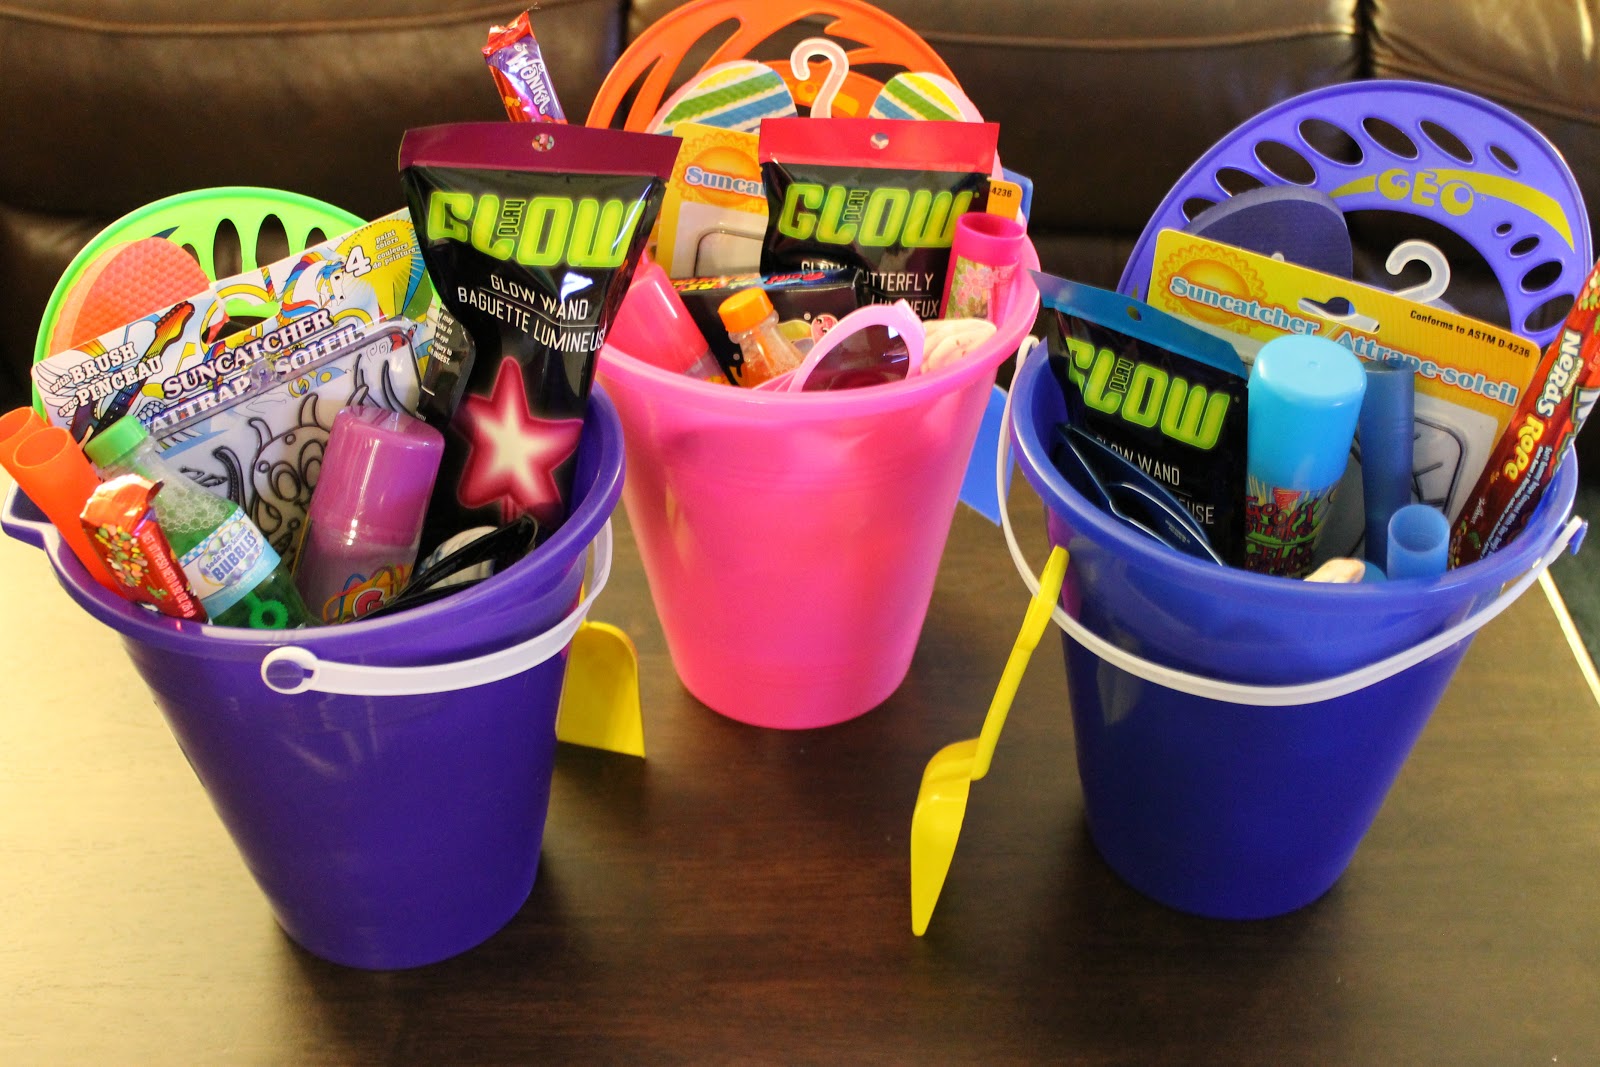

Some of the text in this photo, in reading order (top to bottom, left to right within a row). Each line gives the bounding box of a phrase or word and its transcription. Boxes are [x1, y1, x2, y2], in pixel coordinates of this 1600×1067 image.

[778, 182, 973, 248] GLOW
[1377, 168, 1474, 216] GEO
[375, 229, 396, 245] paint
[375, 236, 399, 250] colors
[377, 242, 409, 260] couleurs
[427, 190, 646, 268] GLOW
[345, 245, 372, 278] 4
[384, 247, 416, 266] peinture
[490, 273, 589, 320] GLOW WAND
[862, 271, 934, 292] UTTERFLY
[457, 286, 608, 353] BAGUETTE LUMINEUS
[1169, 276, 1322, 337] Suncatcher
[162, 308, 334, 400] SUNCATCHER
[1410, 310, 1530, 358] Conforms to ASTM D-4236
[50, 341, 138, 394] with BRUSH
[58, 354, 163, 417] avec PINCEAU
[1066, 338, 1231, 449] GLOW
[1137, 453, 1180, 486] WAND
[211, 530, 257, 582] BUBBLES
